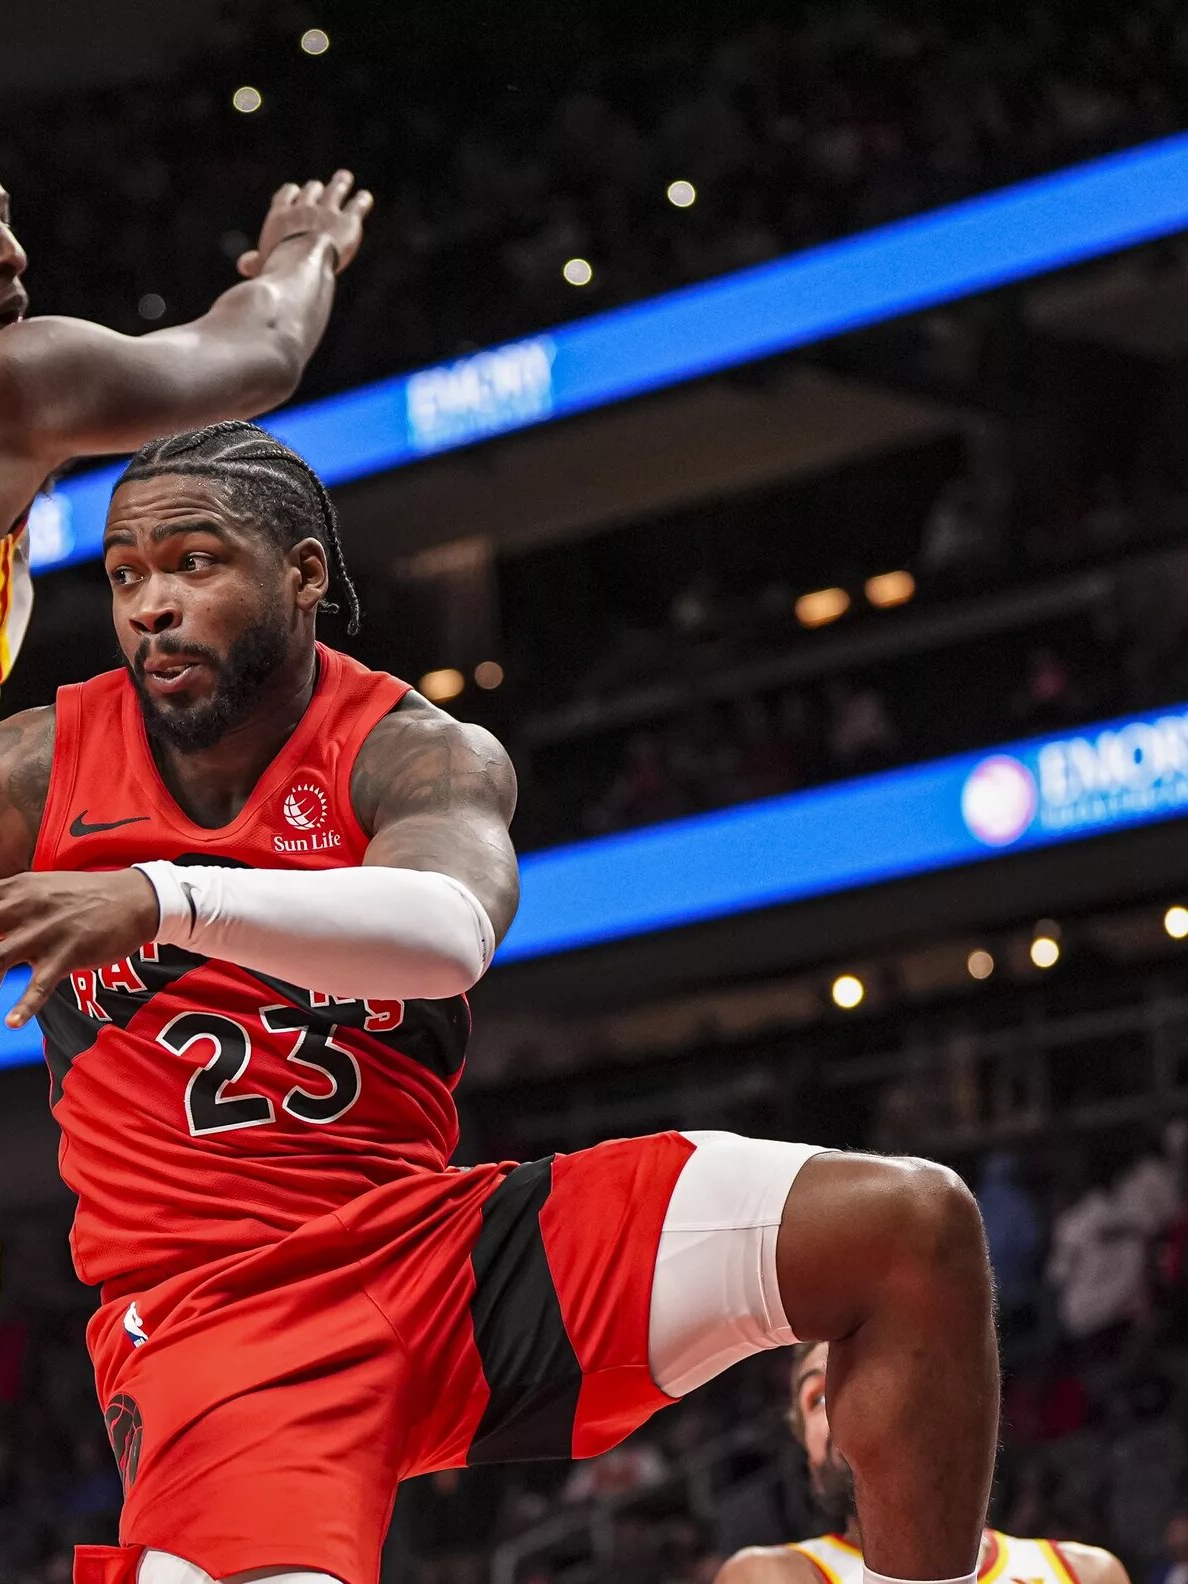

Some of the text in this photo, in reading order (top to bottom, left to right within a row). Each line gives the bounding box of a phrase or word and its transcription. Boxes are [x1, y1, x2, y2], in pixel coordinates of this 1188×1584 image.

[1039, 709, 1188, 807] EMOR
[273, 829, 342, 852] Sun Life
[156, 1004, 362, 1137] 23
